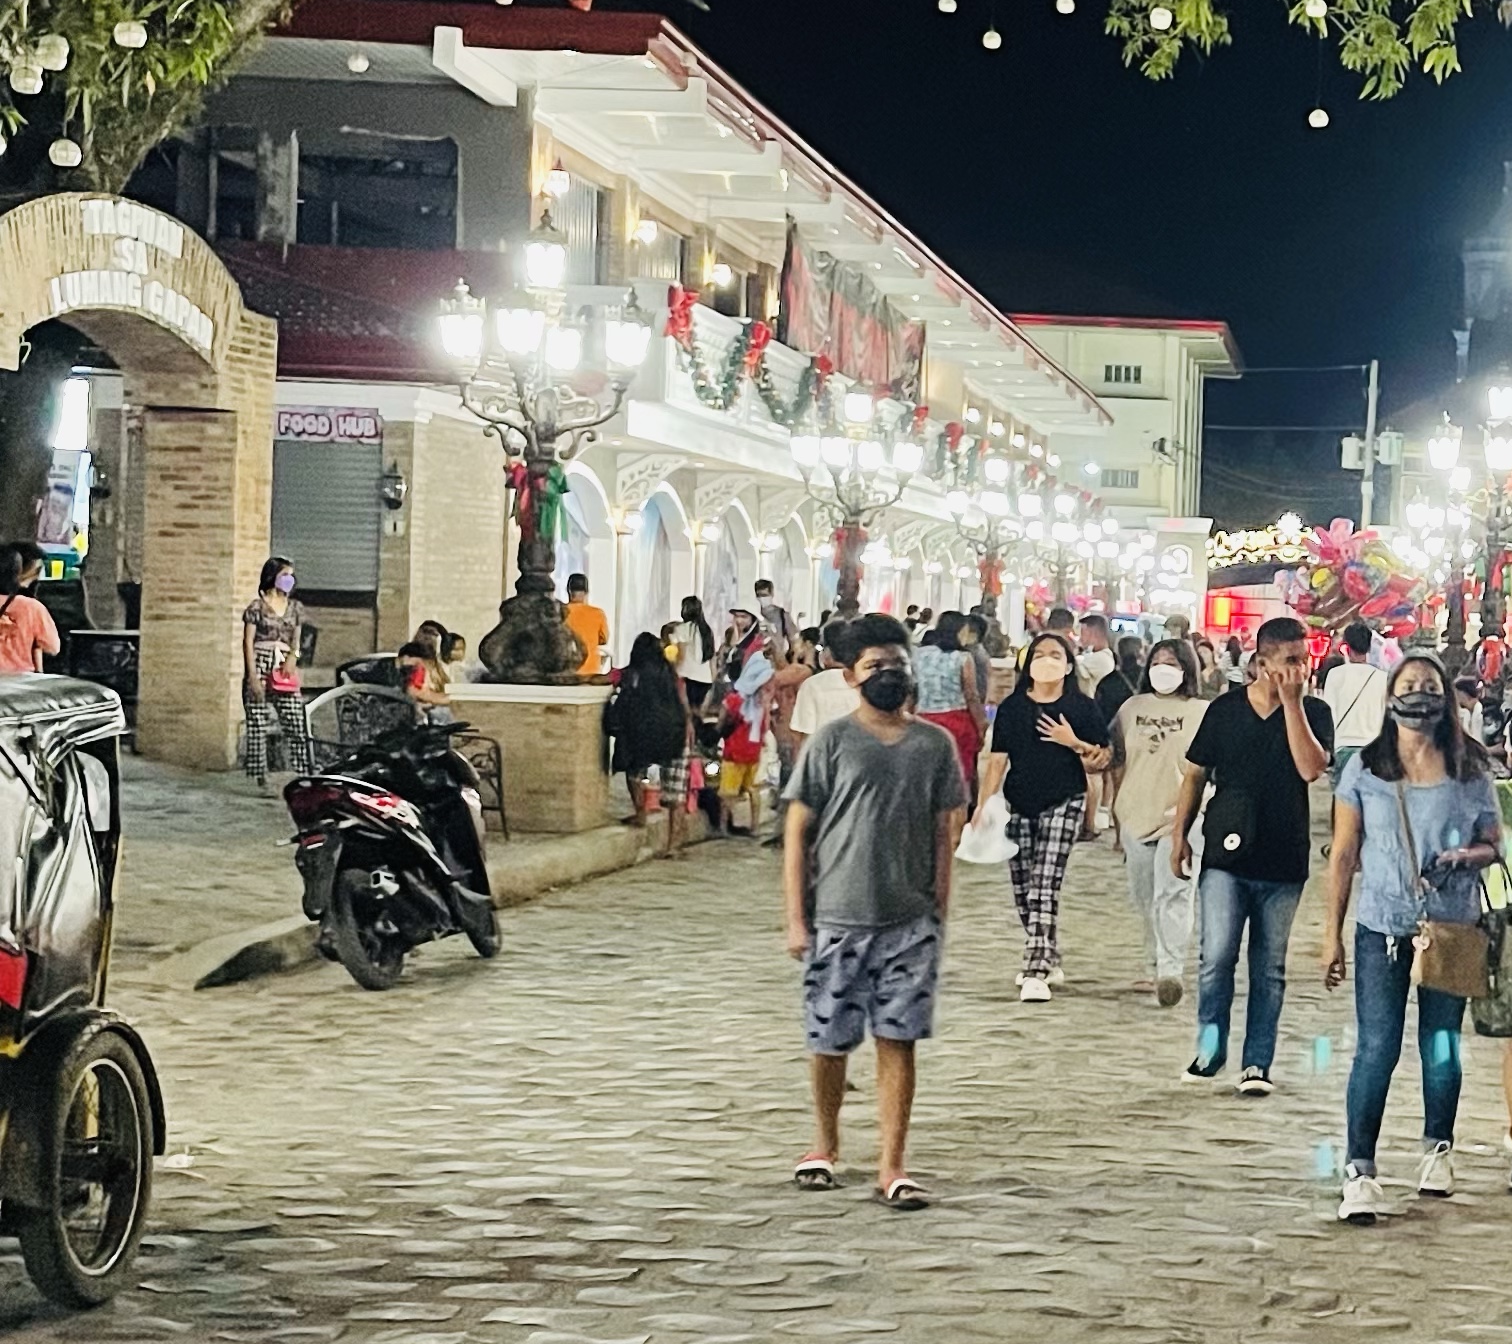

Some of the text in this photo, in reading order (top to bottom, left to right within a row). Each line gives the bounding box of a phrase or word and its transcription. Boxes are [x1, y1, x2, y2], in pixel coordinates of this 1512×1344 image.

[81, 198, 184, 258] TAGPUAN
[115, 238, 148, 275] SA
[51, 270, 214, 350] LUMANG GAPAN
[278, 412, 378, 438] FOOD HUB
